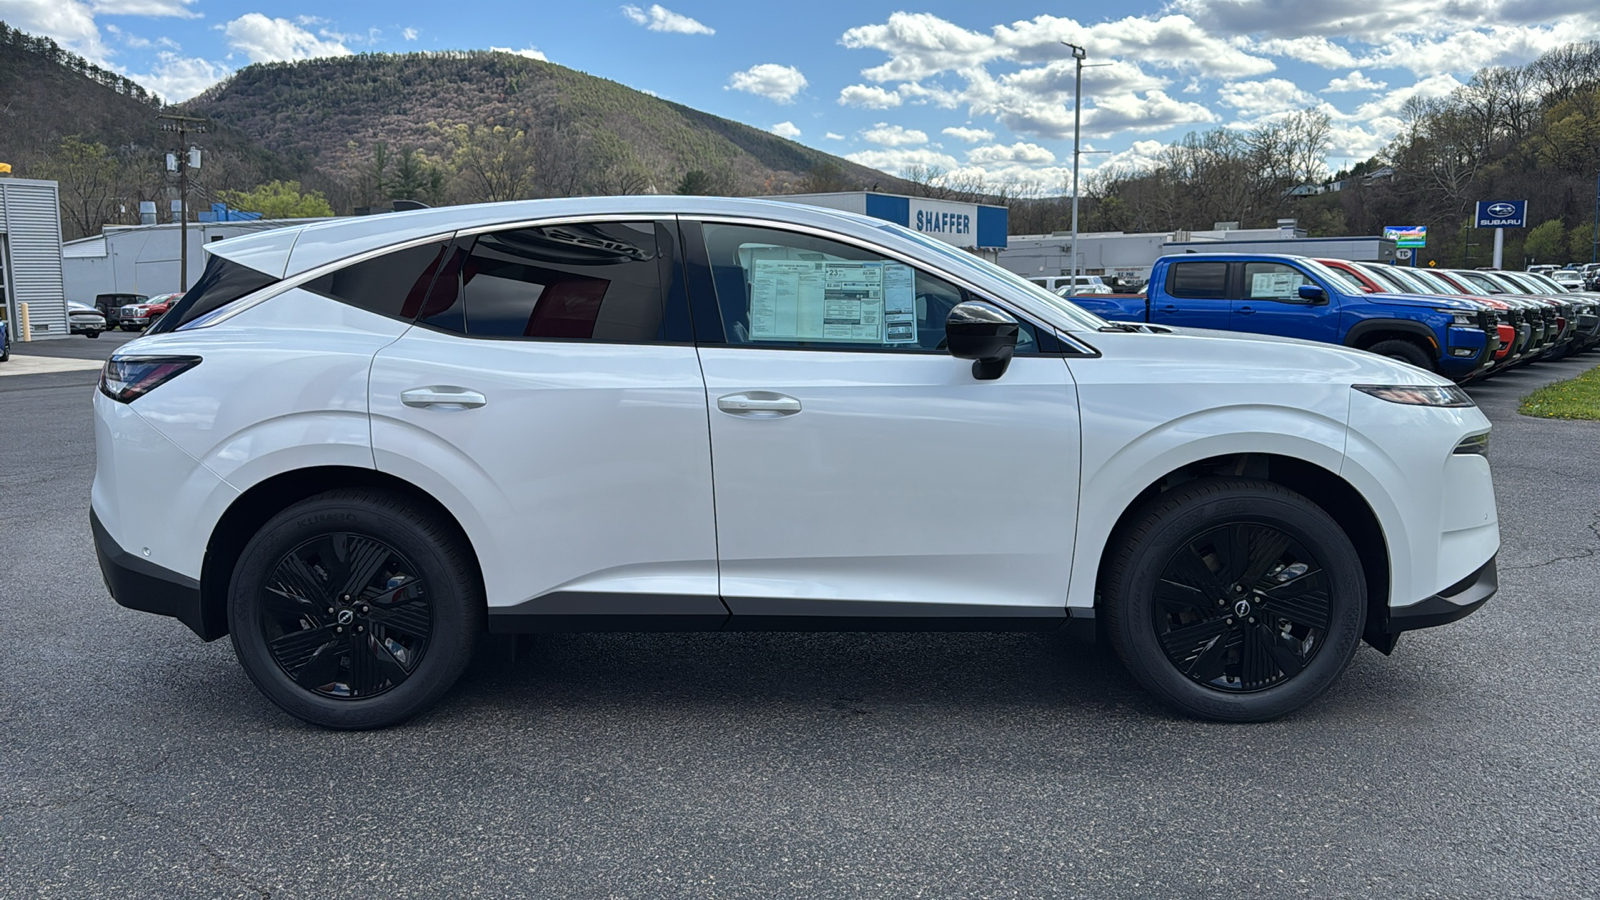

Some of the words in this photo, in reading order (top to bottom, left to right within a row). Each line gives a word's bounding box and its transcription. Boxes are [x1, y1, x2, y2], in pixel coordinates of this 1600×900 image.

[916, 209, 970, 234] SHAFFER
[1399, 250, 1409, 258] TC
[829, 269, 839, 277] 23
[296, 513, 358, 529] KUMHO
